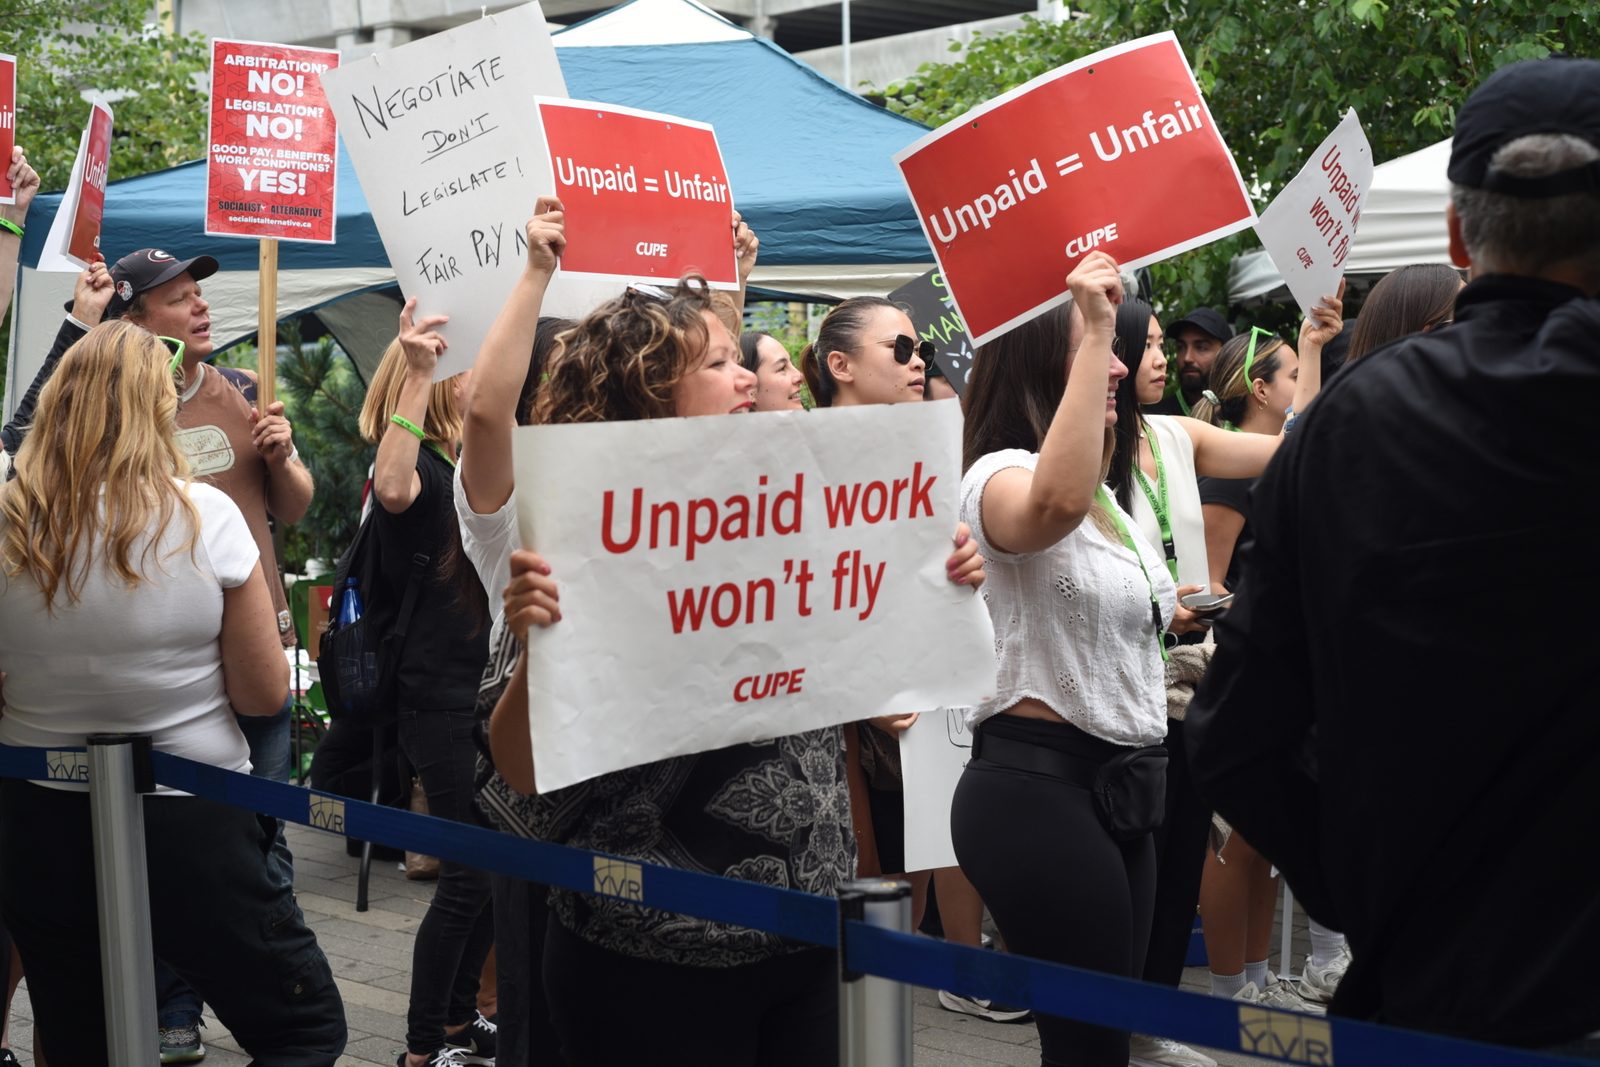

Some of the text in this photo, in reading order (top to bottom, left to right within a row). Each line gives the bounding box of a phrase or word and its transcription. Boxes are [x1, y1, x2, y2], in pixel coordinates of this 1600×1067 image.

[224, 54, 329, 74] ARBITRATION?
[247, 70, 304, 97] NO!
[225, 98, 325, 118] LEGISLATION?
[246, 114, 303, 141] NO!
[212, 144, 334, 163] GOOD PAY, BENEFITS,
[215, 154, 330, 172] WORK CONDITIONS?
[237, 167, 307, 196] YES!
[556, 156, 727, 203] Unpaid = Unfair
[929, 100, 1204, 244] Unpaid = Unfair
[1321, 144, 1361, 214] Unpaid
[218, 201, 322, 217] SOCIALIST ALTERNATIVE
[229, 215, 312, 228] socialistalternative.ca
[470, 222, 503, 268] PAY
[1065, 222, 1119, 258] CUPE
[1309, 196, 1351, 268] won't fly
[636, 241, 668, 257] CUPE
[1296, 247, 1314, 269] CUPE
[601, 461, 938, 561] Unpaid work
[1149, 494, 1162, 514] More
[667, 549, 887, 635] won't fly
[733, 668, 806, 703] CUPE
[47, 762, 89, 781] YVR
[309, 807, 344, 834] YVR
[593, 872, 642, 901] YVR
[1241, 1023, 1333, 1067] YVR
